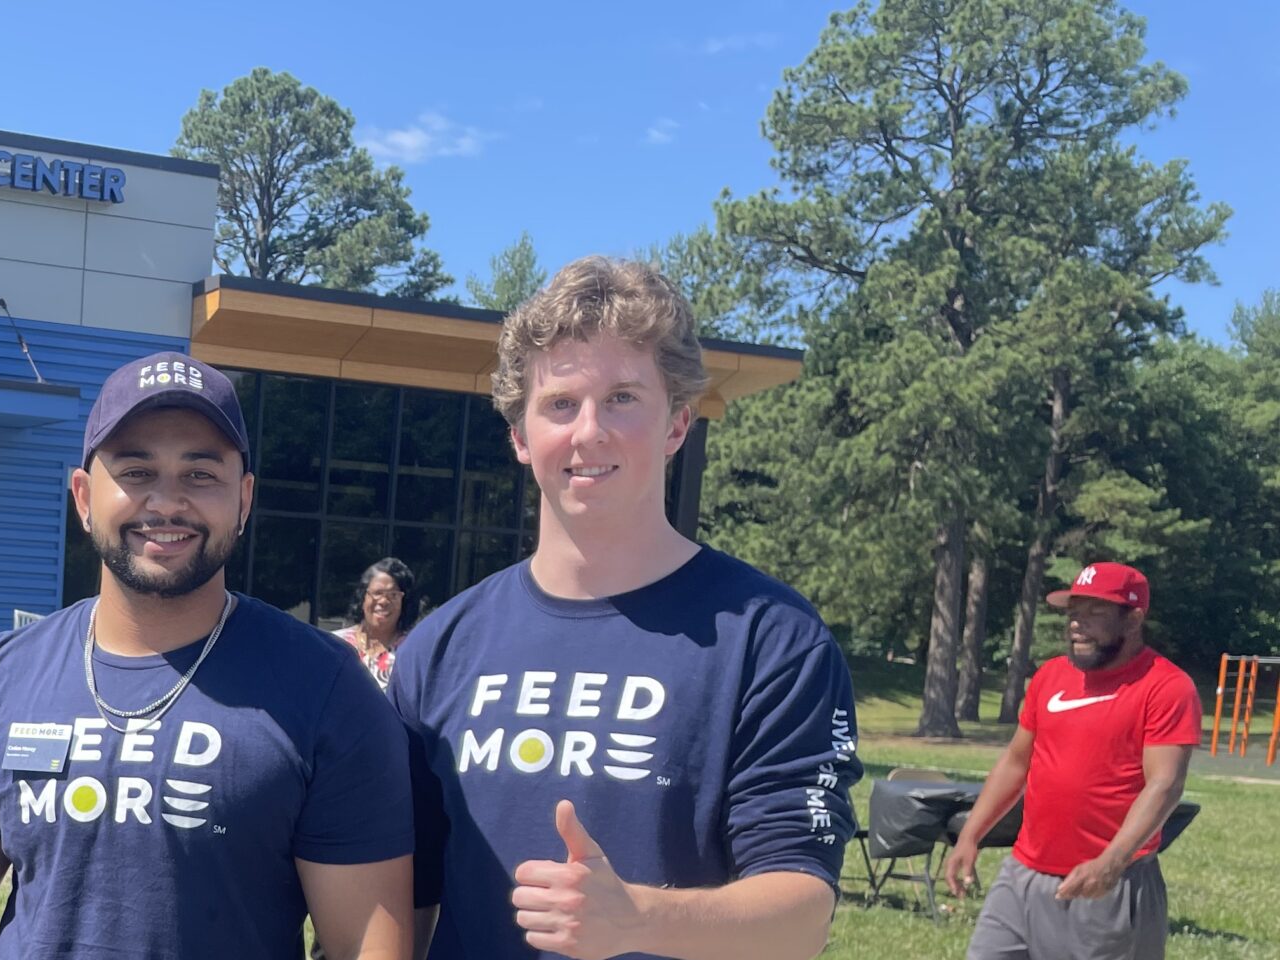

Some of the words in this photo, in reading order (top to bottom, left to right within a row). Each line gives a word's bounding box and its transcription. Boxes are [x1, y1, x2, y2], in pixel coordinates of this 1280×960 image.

[140, 361, 202, 378] FEED
[470, 670, 666, 721] FEED
[69, 717, 222, 767] EED
[458, 728, 657, 781] MORE
[18, 776, 213, 829] MORE
